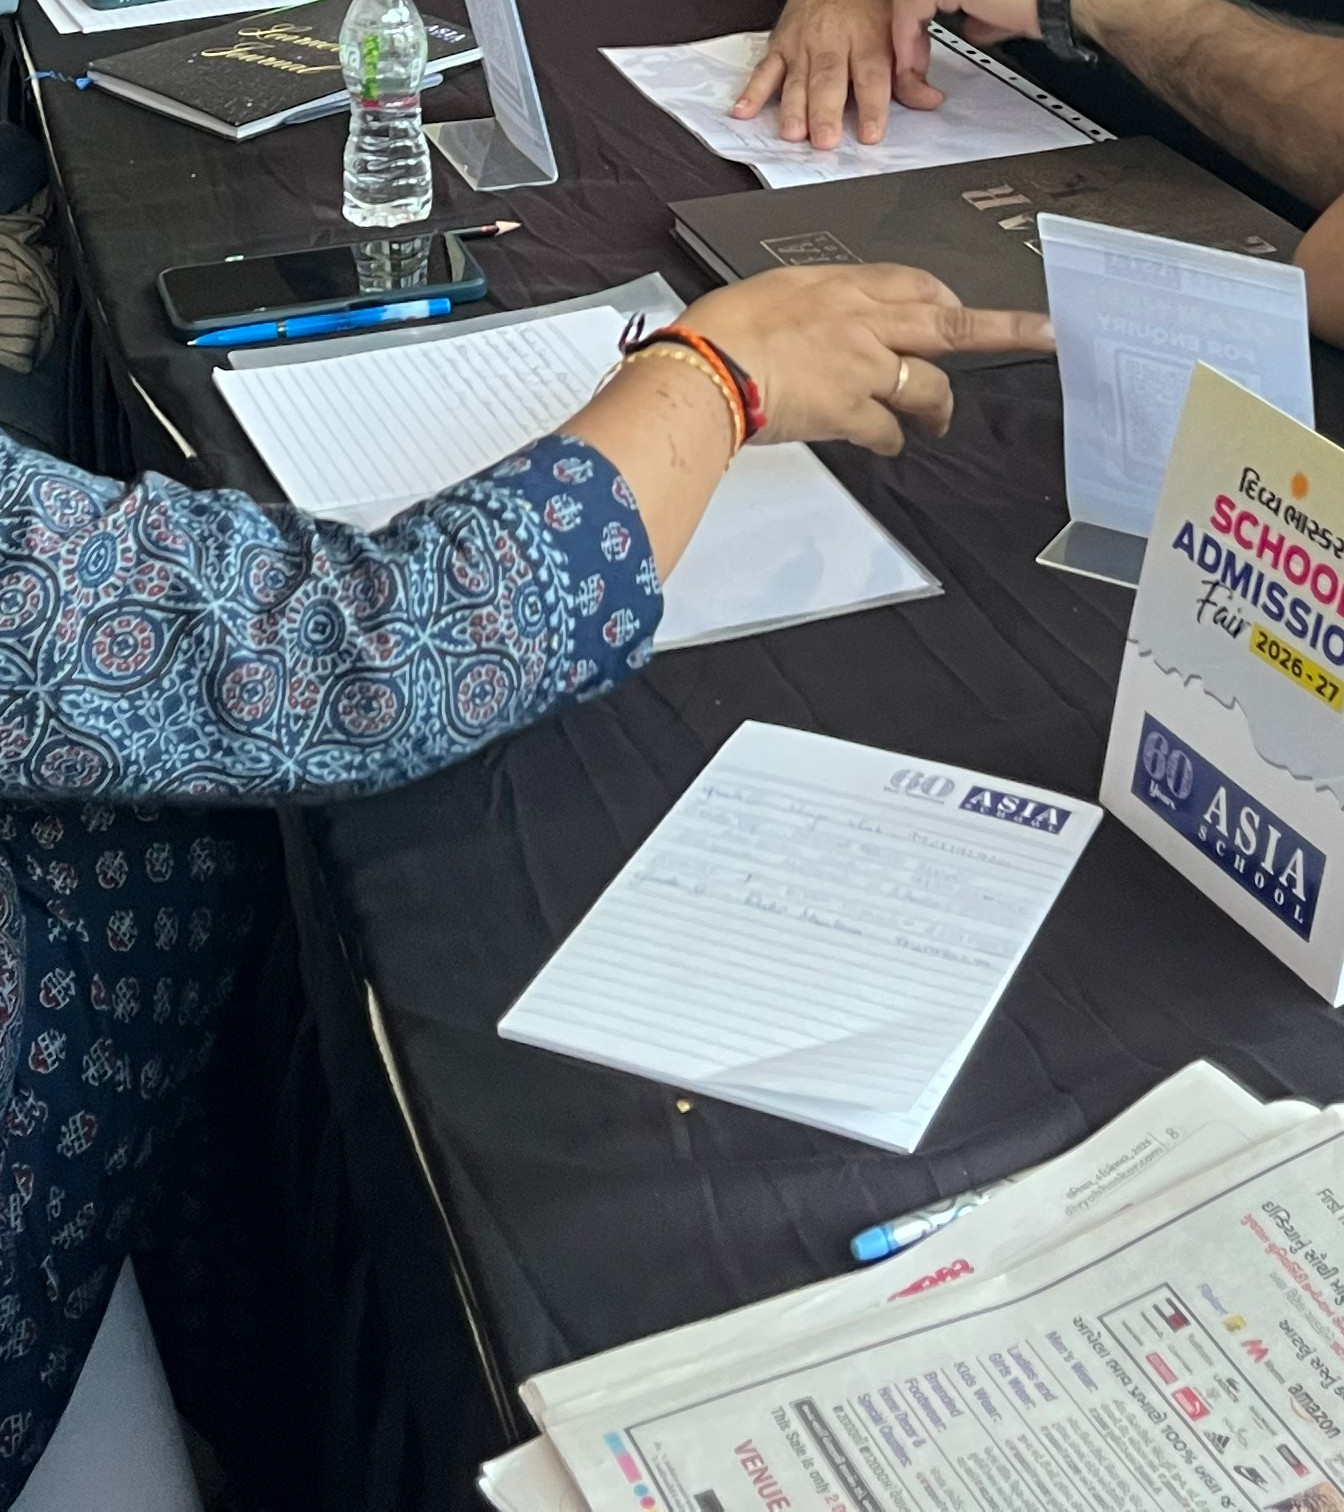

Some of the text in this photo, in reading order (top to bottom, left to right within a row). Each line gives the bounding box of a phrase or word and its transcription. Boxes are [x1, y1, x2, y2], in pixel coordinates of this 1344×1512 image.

[1240, 465, 1283, 519] દિવ્ય
[1195, 579, 1252, 640] Fair
[968, 790, 1059, 827] ASIA
[1142, 729, 1308, 902] 60 ASIA
[1197, 824, 1306, 925] SCHOOL
[1313, 1187, 1344, 1213] First
[985, 1350, 1014, 1378] Girls
[1003, 1343, 1059, 1402] Ladies and
[1042, 1330, 1078, 1363] Men's
[922, 1370, 965, 1418] Branded
[950, 1360, 981, 1388] Kids
[1285, 1382, 1344, 1439] amazon
[769, 1406, 841, 1504] This Sale is only 2
[1157, 1424, 1201, 1465] 100%
[730, 1437, 793, 1512] VENUE
